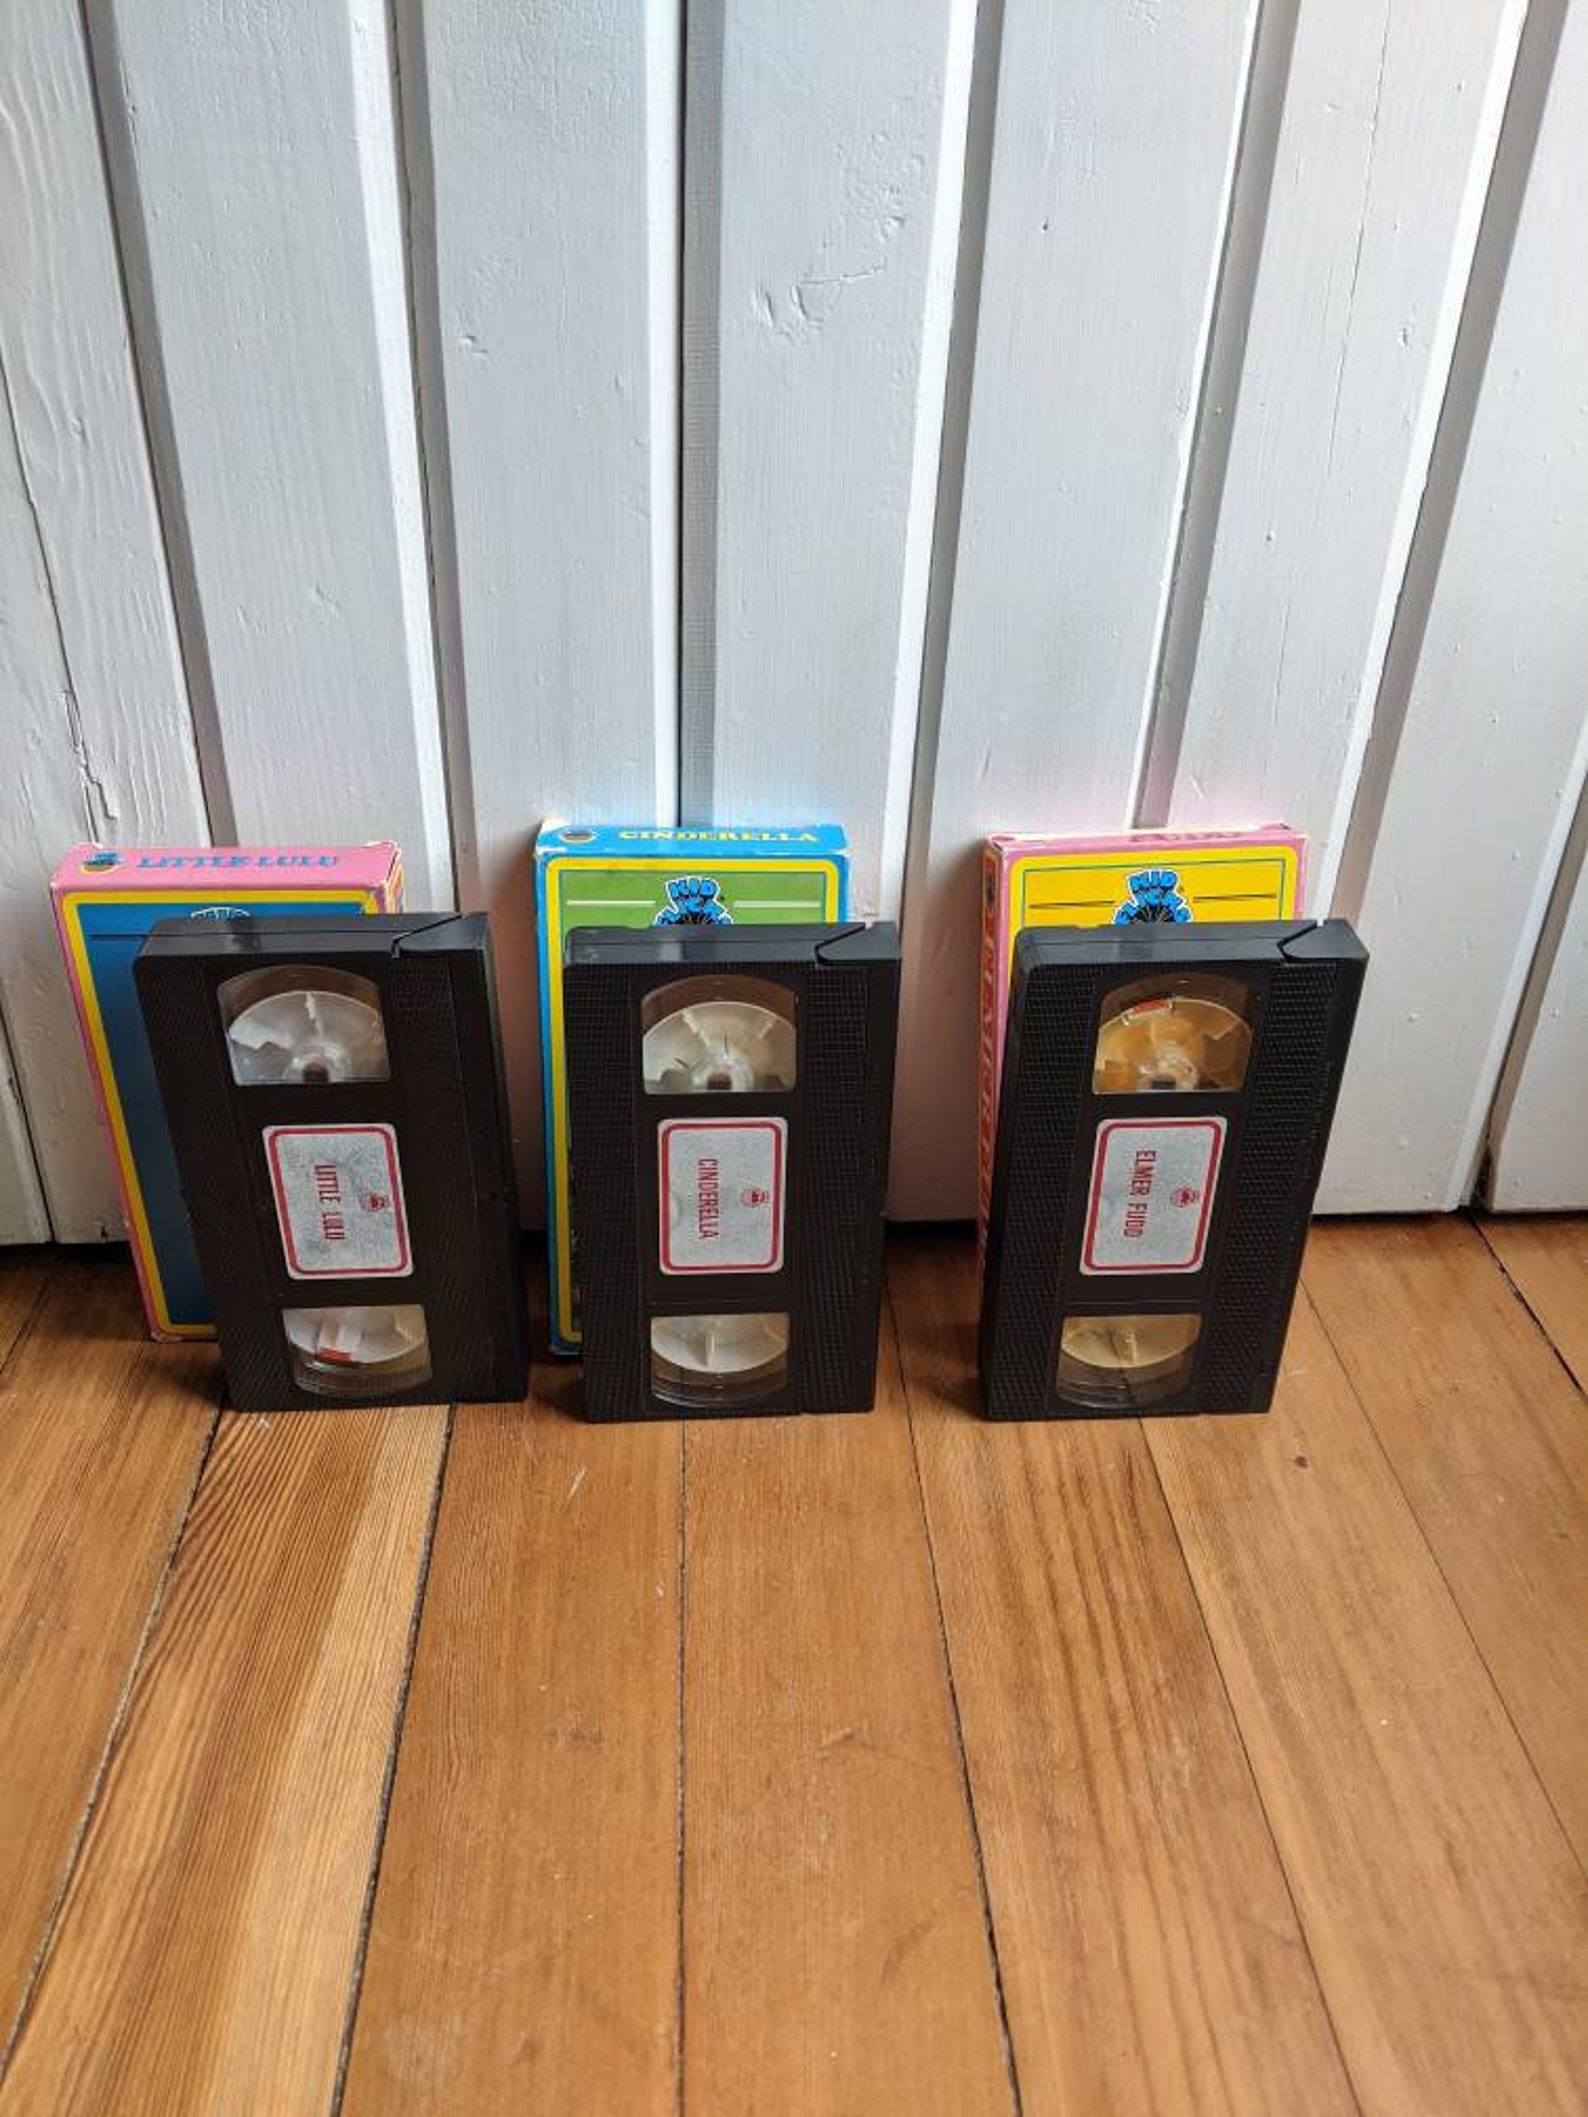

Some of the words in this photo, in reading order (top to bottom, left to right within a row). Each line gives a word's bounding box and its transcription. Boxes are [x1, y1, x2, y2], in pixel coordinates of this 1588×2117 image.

[618, 830, 818, 842] CINDERELLA
[137, 856, 251, 868] LITTLE
[258, 856, 338, 868] LULU
[668, 877, 719, 900] KID
[1129, 869, 1179, 893] KID
[314, 1165, 341, 1203] LITTLE
[1130, 1151, 1157, 1196] ELMER
[698, 1158, 719, 1240] CINDERELLA
[322, 1212, 346, 1240] LULU
[1124, 1203, 1147, 1238] FUDD
